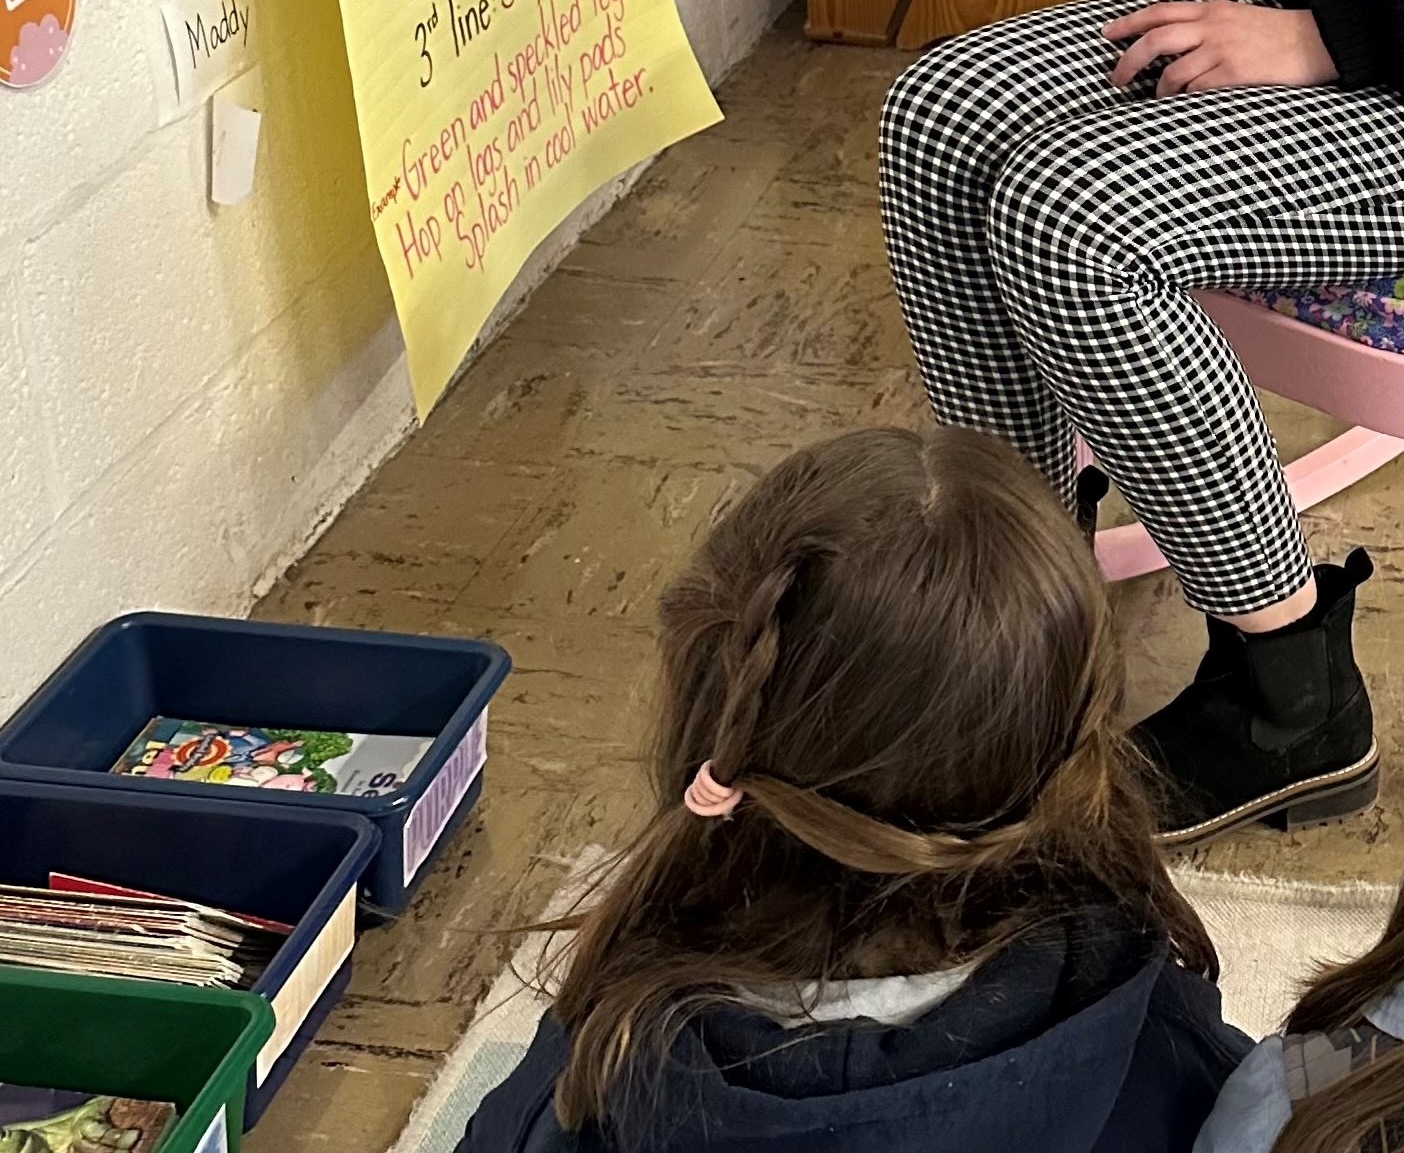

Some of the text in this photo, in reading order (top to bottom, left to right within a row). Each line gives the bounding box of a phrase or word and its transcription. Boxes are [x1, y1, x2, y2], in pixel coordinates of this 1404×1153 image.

[413, 1, 440, 89] 3rd
[394, 208, 444, 281] Hop
[442, 179, 466, 224] on
[466, 135, 504, 198] logs
[506, 76, 541, 154] and
[543, 52, 575, 116] lily
[401, 116, 467, 202] Green
[469, 51, 506, 132] and
[454, 163, 521, 274] Splash
[522, 154, 541, 192] in
[545, 101, 577, 170] cool
